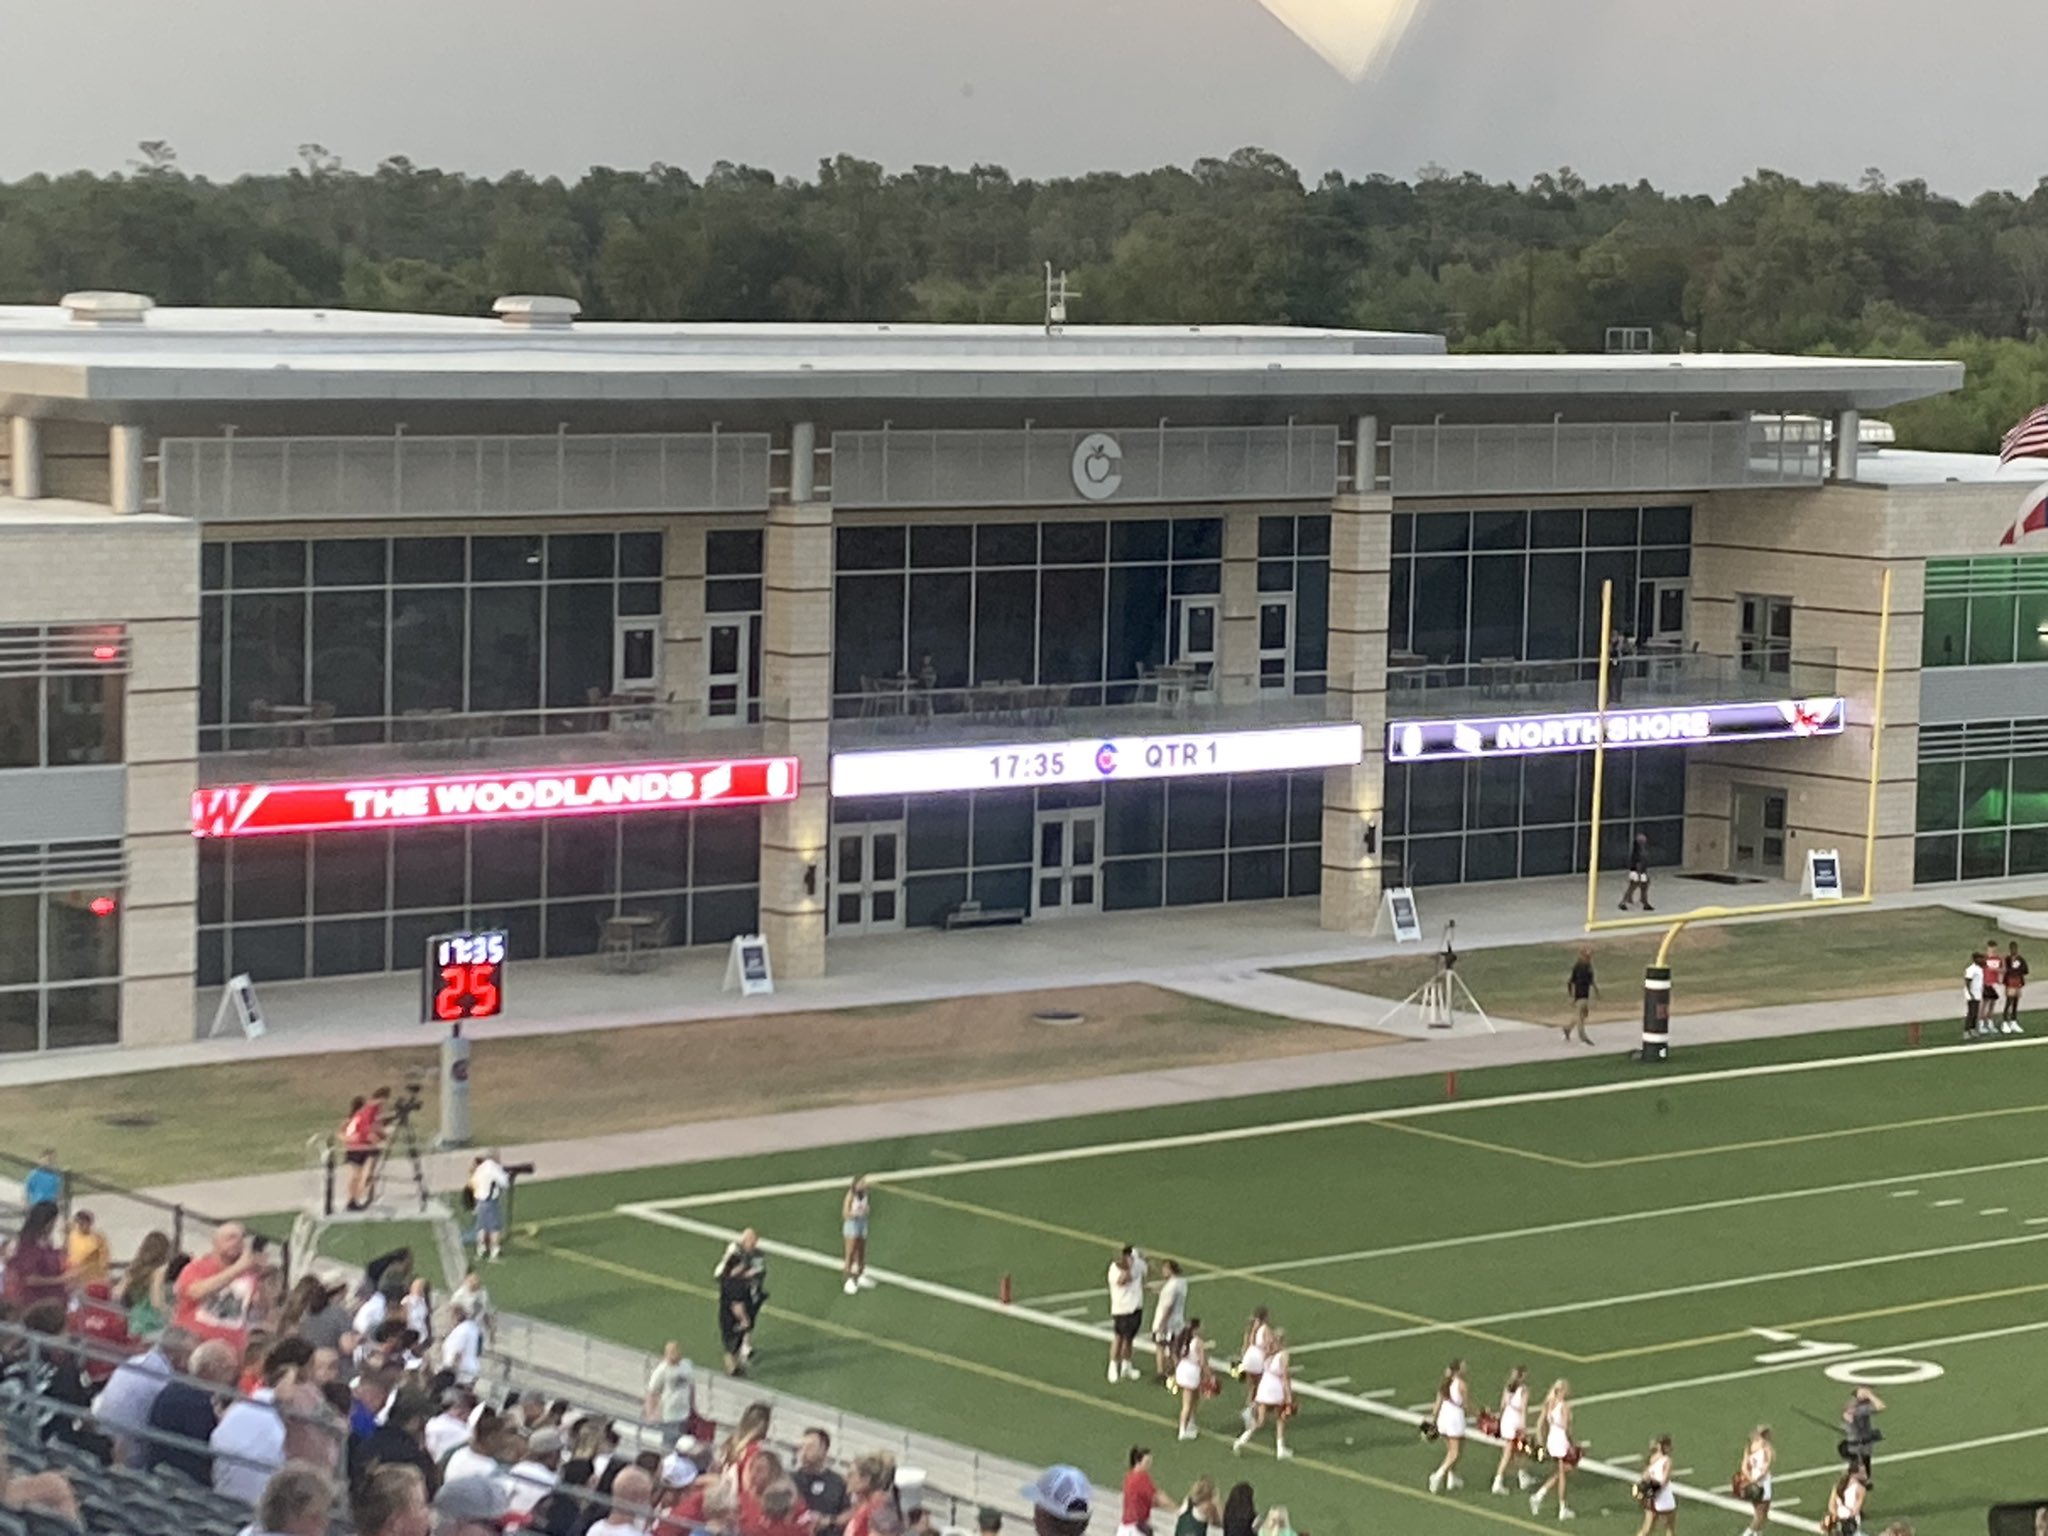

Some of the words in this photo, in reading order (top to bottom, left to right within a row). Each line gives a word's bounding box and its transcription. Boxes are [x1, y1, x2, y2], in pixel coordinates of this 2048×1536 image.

[1496, 717, 1600, 748] NORTH
[1606, 712, 1710, 742] SHORE
[990, 753, 1065, 778] 17:35
[1145, 743, 1198, 767] QTR
[1206, 741, 1217, 763] 1
[345, 787, 430, 818] THE
[434, 771, 695, 815] WOODLANDS
[436, 965, 496, 1018] 25
